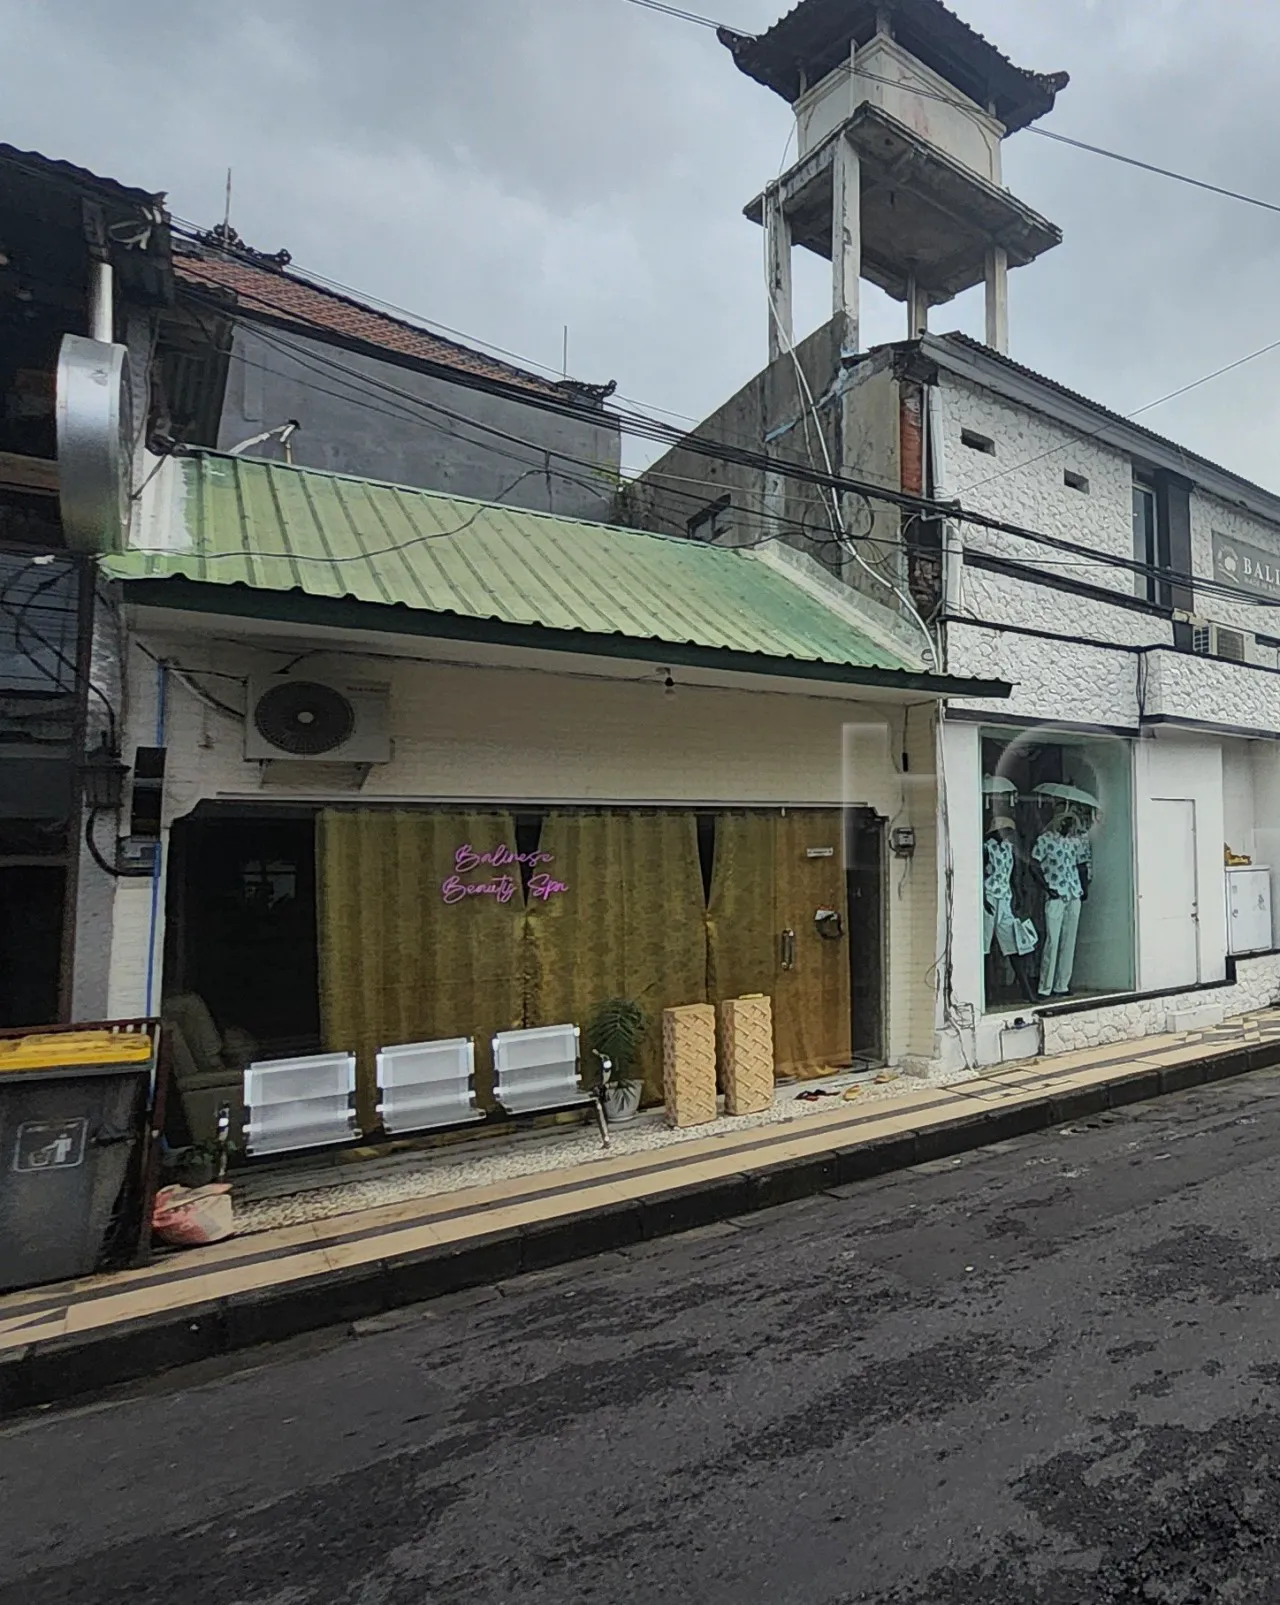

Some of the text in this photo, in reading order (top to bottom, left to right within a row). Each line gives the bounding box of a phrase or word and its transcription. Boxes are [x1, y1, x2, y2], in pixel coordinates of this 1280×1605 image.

[1243, 556, 1280, 586] BALI
[455, 844, 555, 873] Balinese
[442, 873, 569, 904] Beauty Spa
